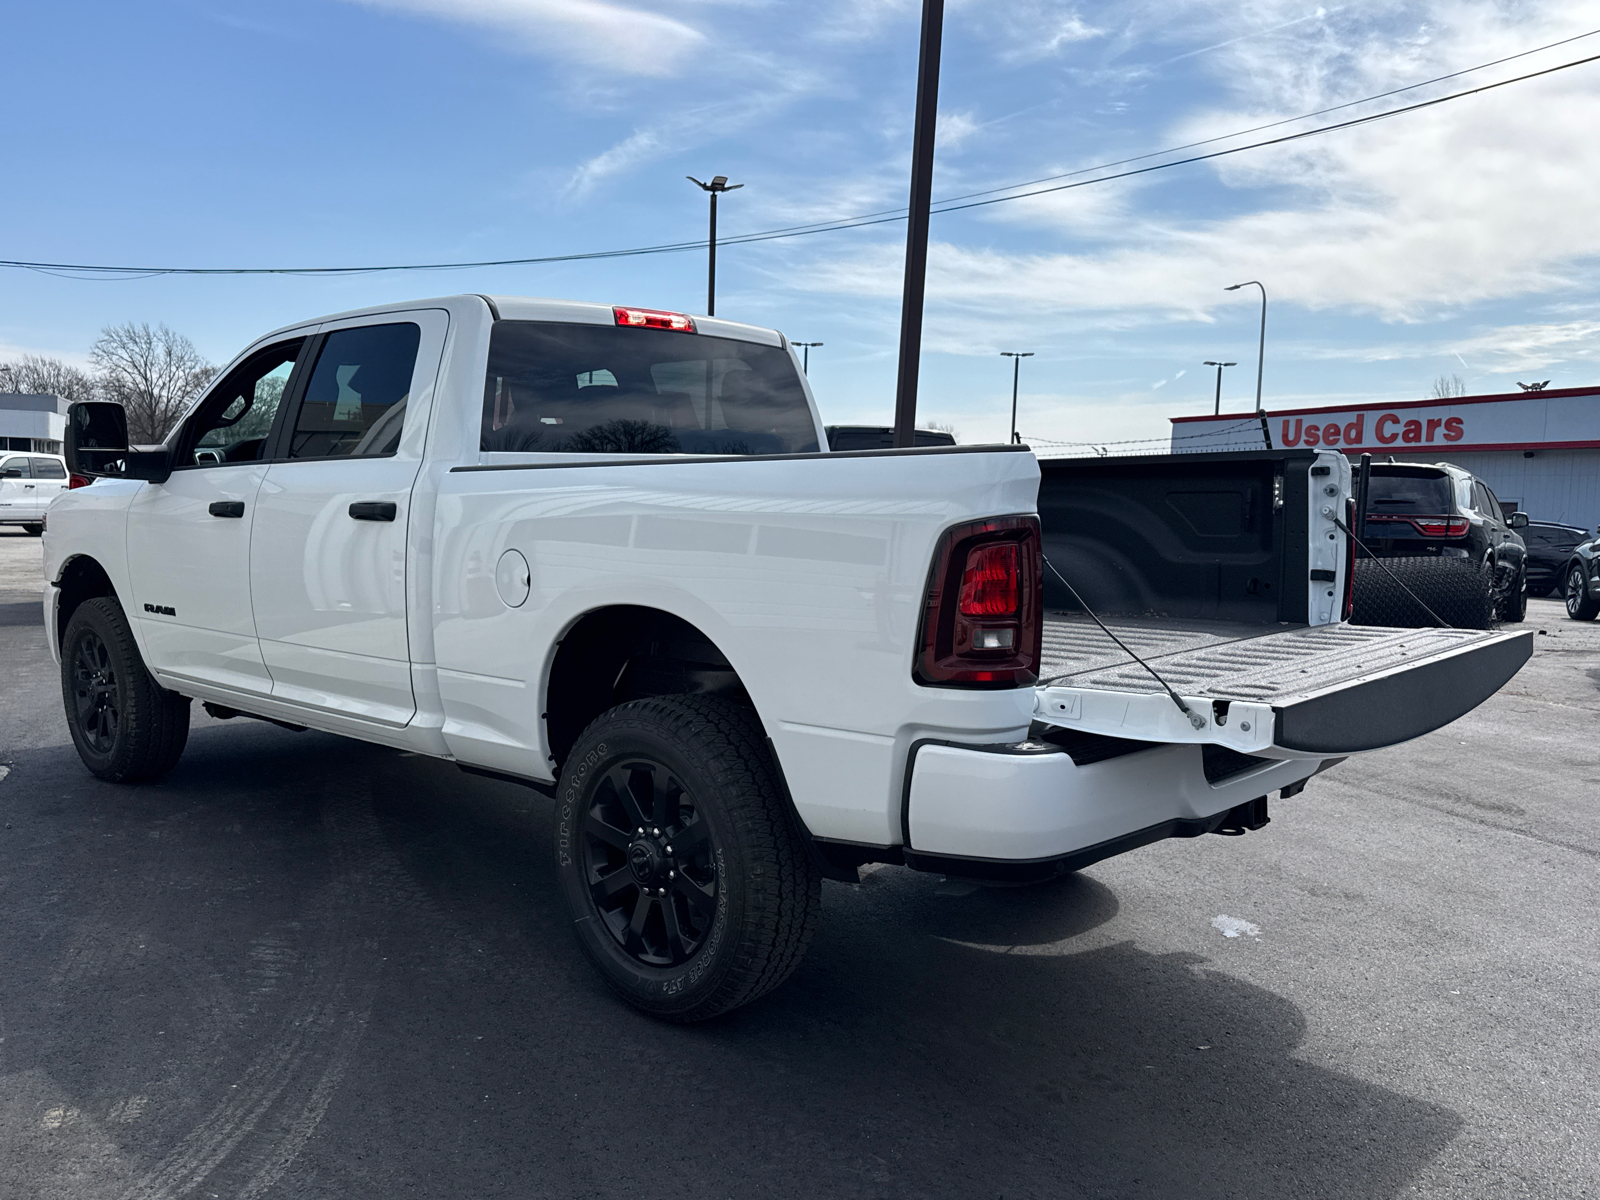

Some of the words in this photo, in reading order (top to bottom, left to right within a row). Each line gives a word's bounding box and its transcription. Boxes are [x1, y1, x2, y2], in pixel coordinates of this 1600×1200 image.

[1282, 413, 1364, 447] Used
[1375, 413, 1464, 444] Cars
[144, 603, 176, 617] RAM
